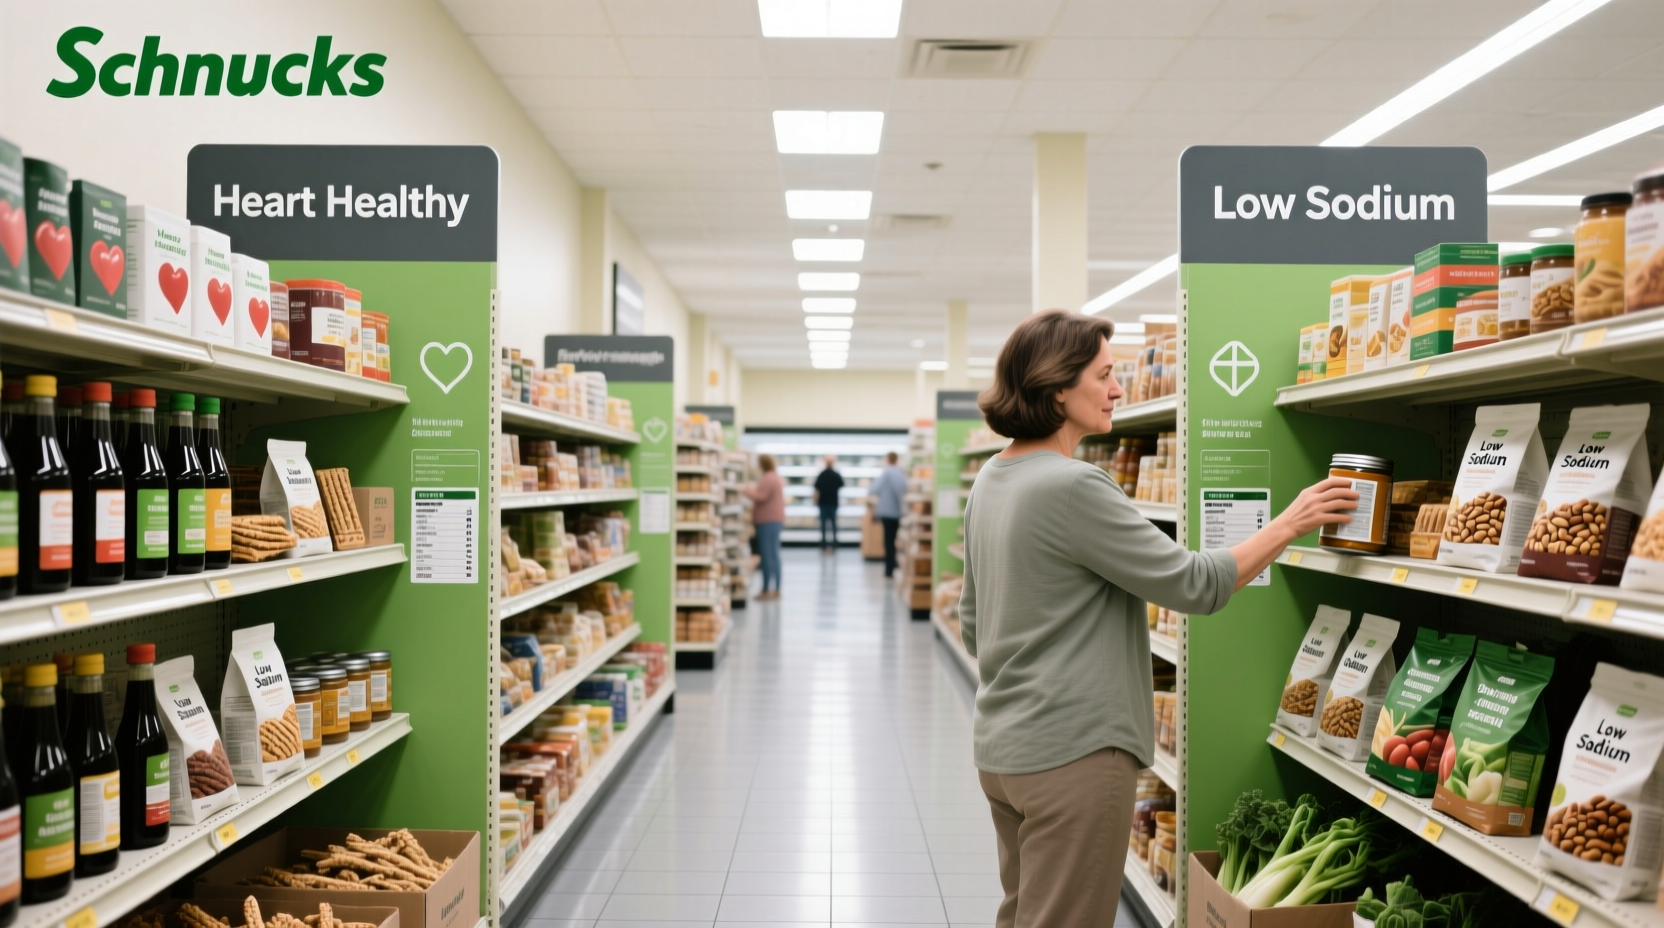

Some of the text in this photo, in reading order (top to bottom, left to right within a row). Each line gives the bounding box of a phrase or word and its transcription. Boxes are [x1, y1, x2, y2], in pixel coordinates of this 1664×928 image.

[214, 185, 470, 228] Heart Healthy
[1214, 184, 1455, 220] Low Sodium
[1480, 440, 1504, 451] Low
[1578, 443, 1606, 454] Low
[1597, 719, 1627, 740] Low
